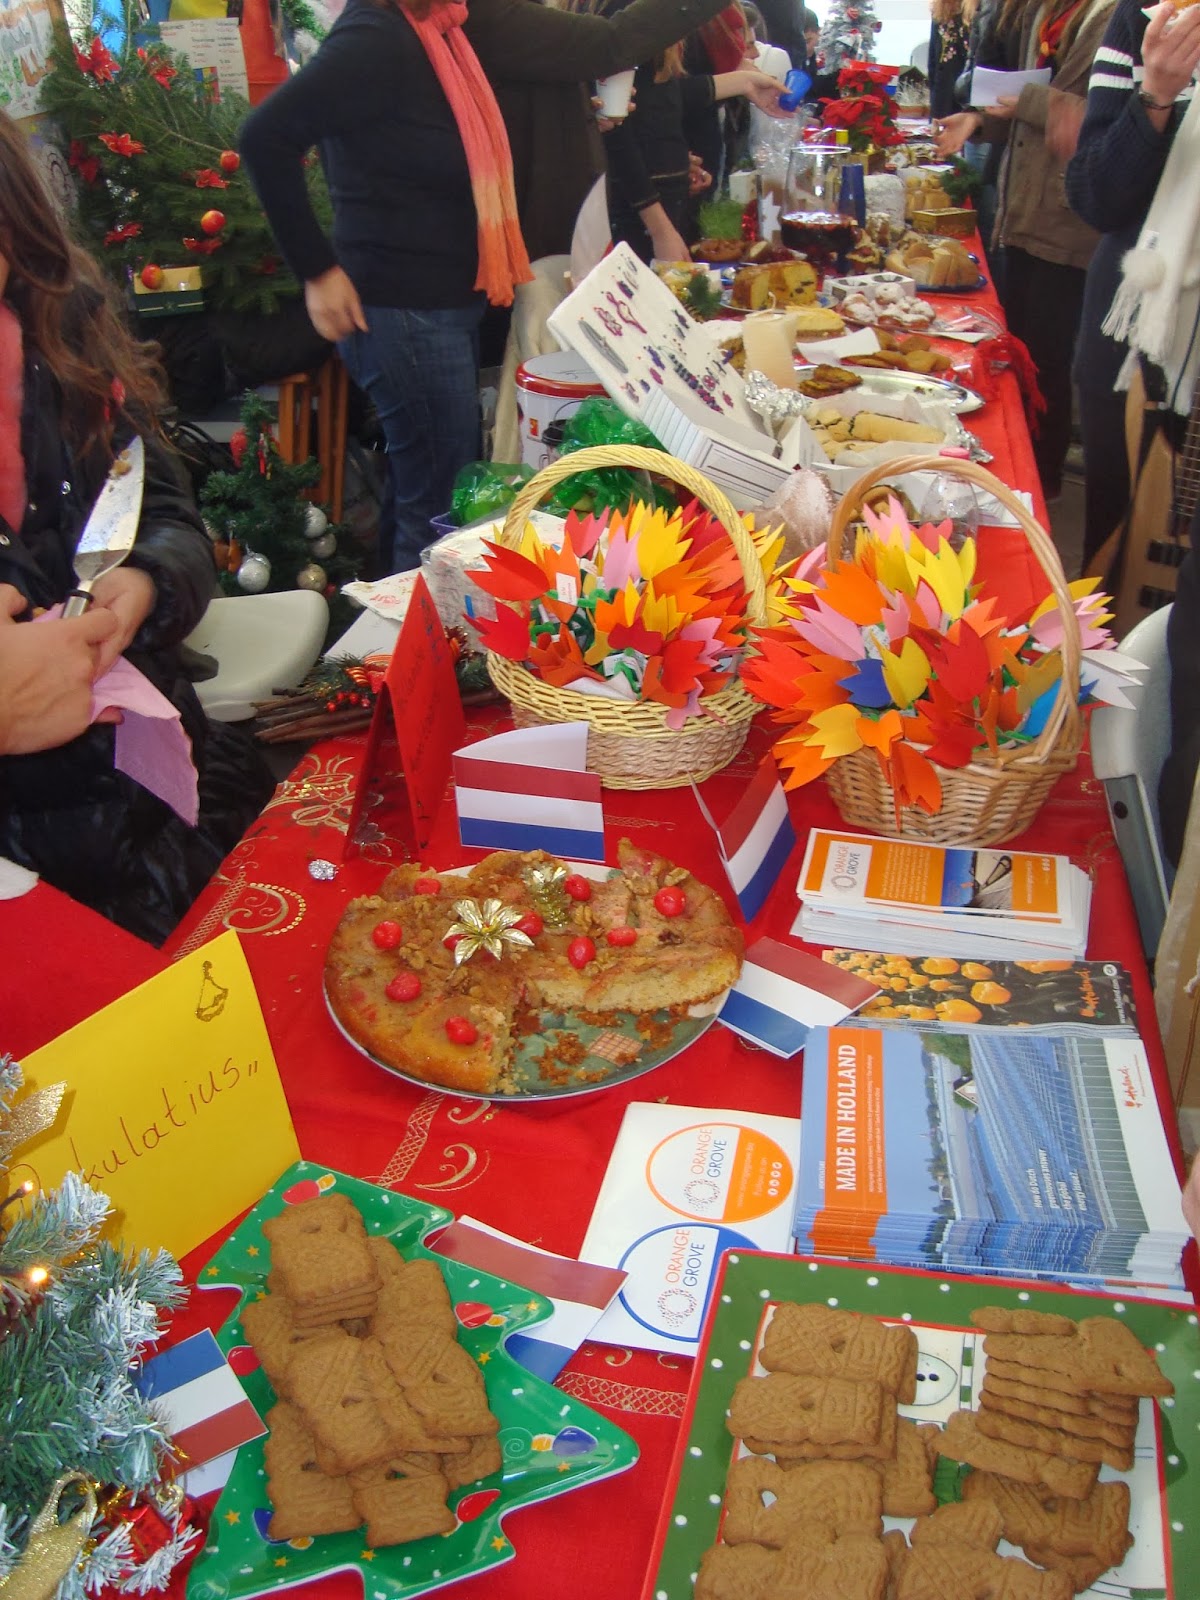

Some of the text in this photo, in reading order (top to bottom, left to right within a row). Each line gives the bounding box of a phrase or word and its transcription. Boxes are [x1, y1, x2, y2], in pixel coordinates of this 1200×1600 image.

[834, 845, 849, 874] ORANGE
[847, 852, 861, 875] GROVE
[836, 1044, 857, 1191] MADE IN HOLLAND
[690, 1129, 713, 1175] ORANGE
[706, 1139, 727, 1178] GROVE
[665, 1229, 690, 1284] ORANGE
[682, 1242, 705, 1287] GROVE
